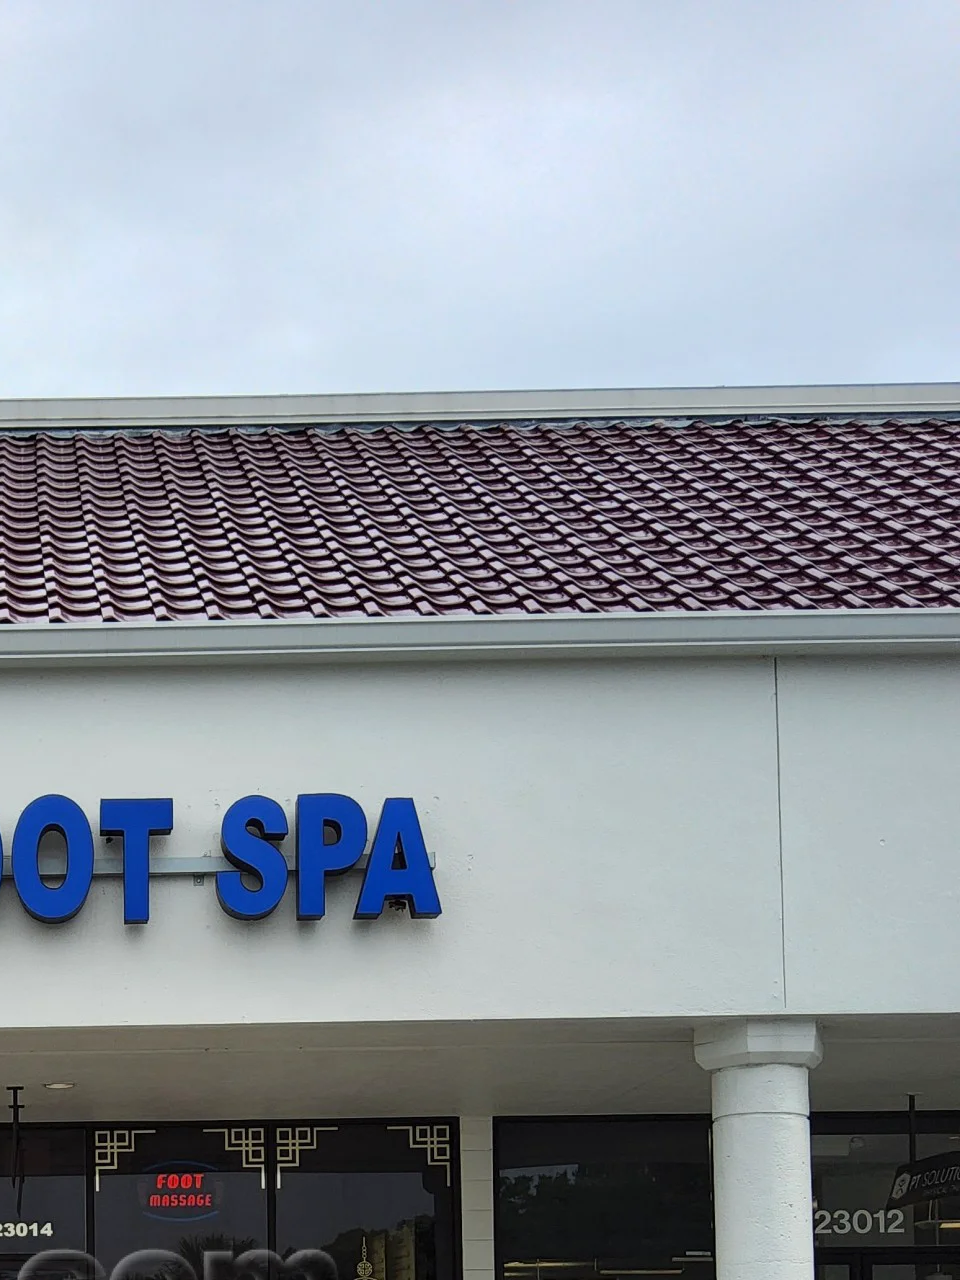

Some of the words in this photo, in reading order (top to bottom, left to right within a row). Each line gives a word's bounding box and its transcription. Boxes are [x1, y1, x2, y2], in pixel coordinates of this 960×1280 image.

[215, 793, 442, 924] SPA
[156, 1173, 204, 1189] FOOT
[149, 1194, 212, 1207] MASSAGE
[814, 1209, 905, 1234] 23012
